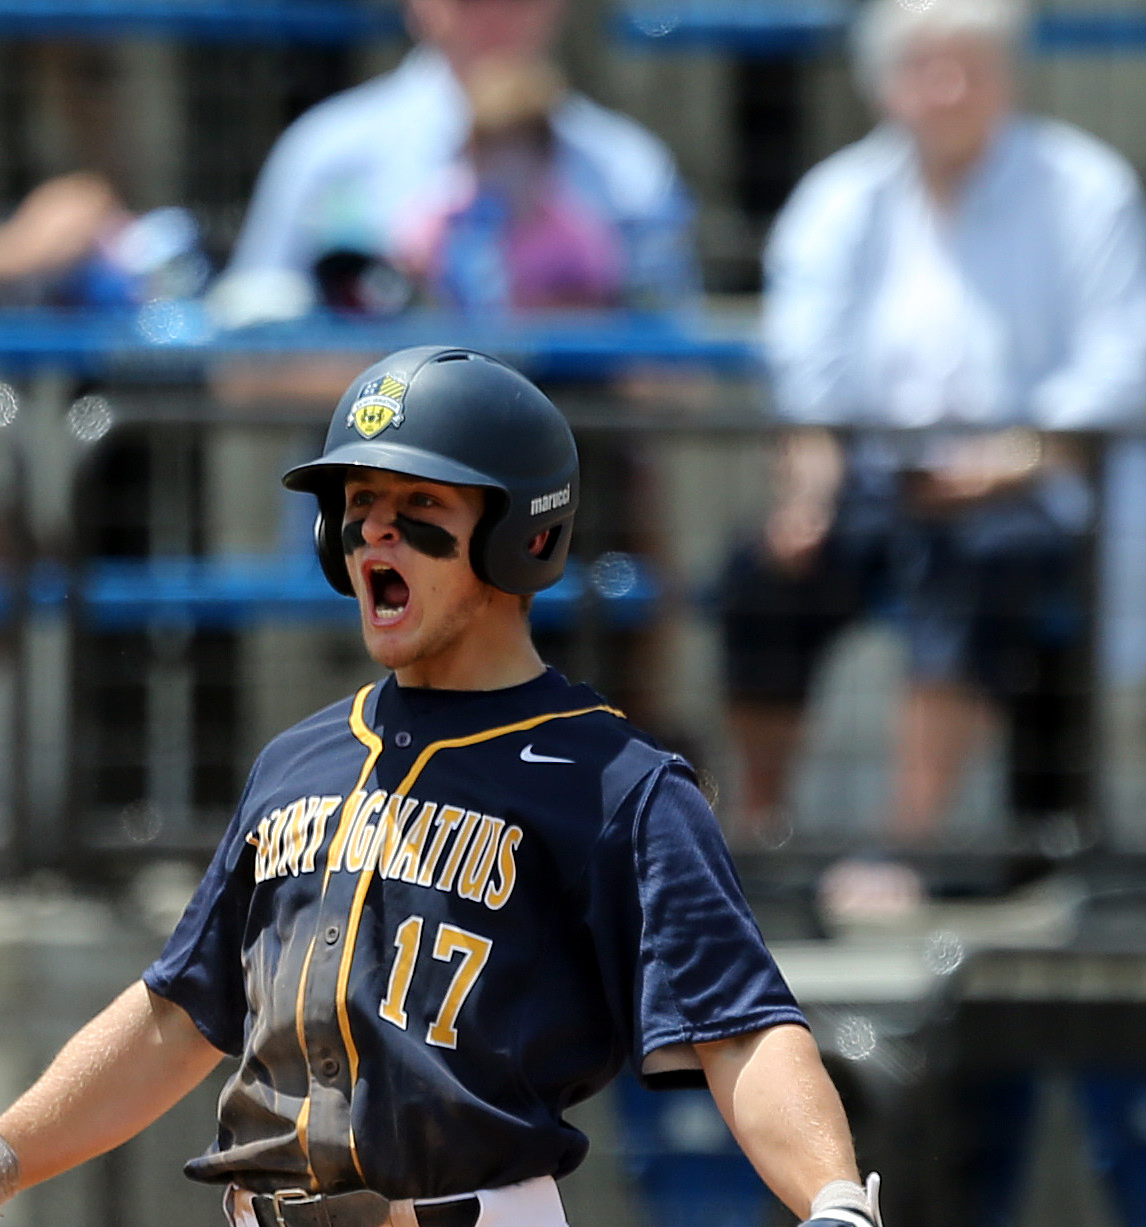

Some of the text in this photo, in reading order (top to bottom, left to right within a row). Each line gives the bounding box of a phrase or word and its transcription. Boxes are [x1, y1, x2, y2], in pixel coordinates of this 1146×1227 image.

[531, 482, 570, 516] marucci
[245, 788, 523, 910] AINT IGNATIUS
[379, 916, 493, 1050] 17
